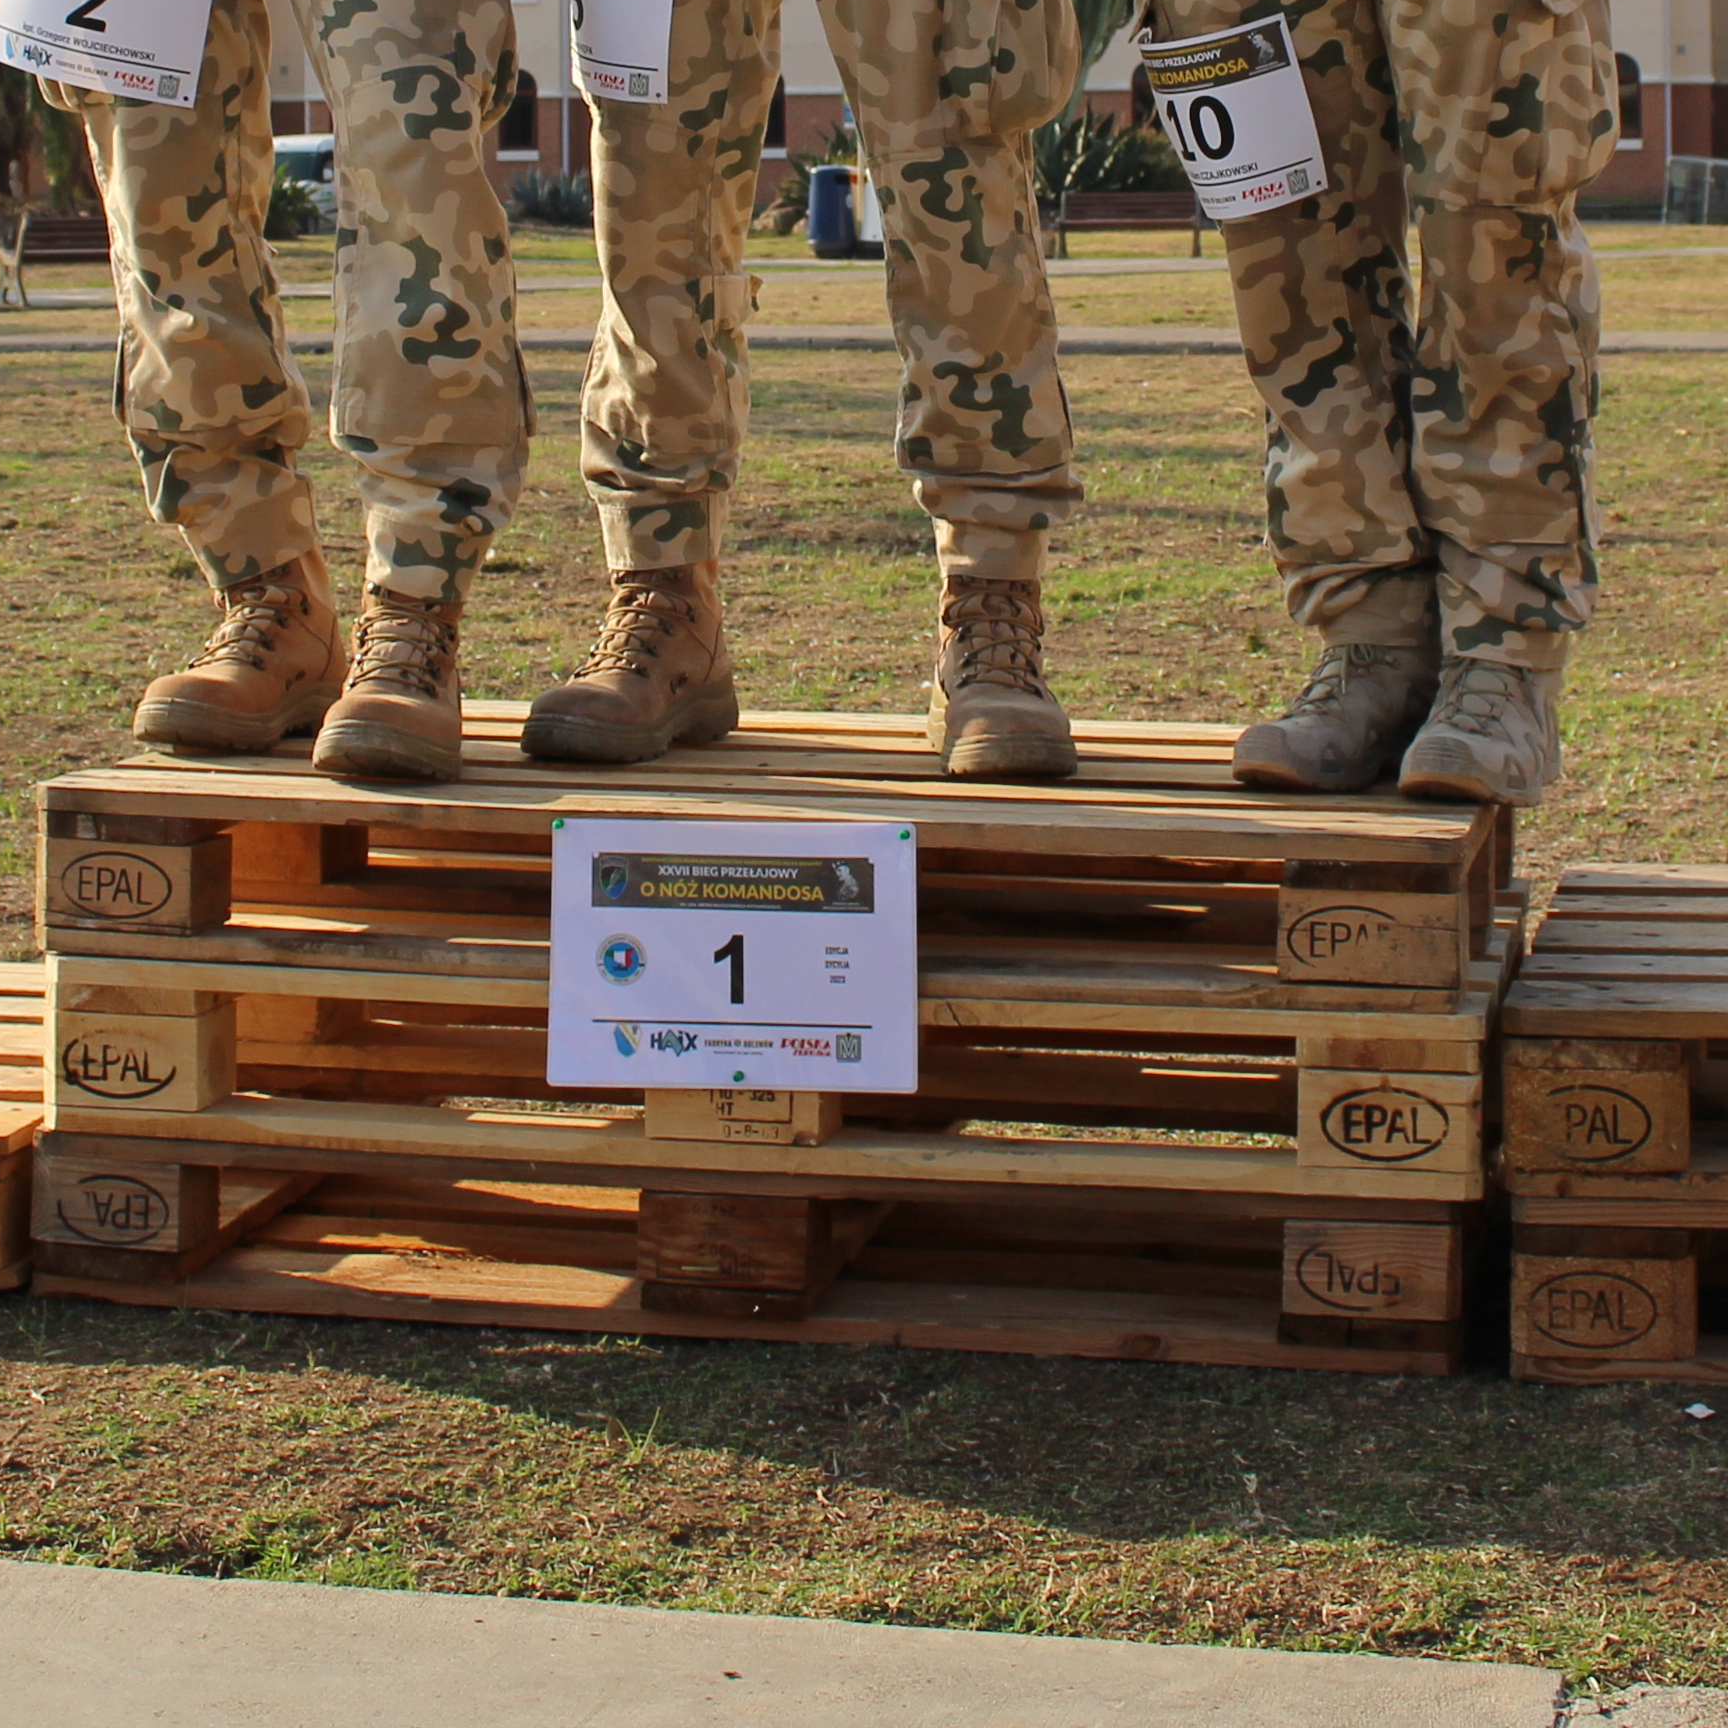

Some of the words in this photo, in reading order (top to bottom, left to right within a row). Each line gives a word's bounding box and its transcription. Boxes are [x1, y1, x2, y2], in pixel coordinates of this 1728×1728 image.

[36, 26, 72, 45] Grzegorz
[73, 37, 156, 62] WOJCIECHOWSKI
[1164, 48, 1222, 68] PRZEŁAJOWY
[1160, 57, 1249, 85] KOMANDOSA
[1166, 95, 1236, 162] 10
[1201, 162, 1259, 181] CZAJKOWSKI
[658, 865, 690, 876] XXVII
[692, 865, 719, 877] BIEG
[721, 866, 799, 880] PRZEŁAJOWY
[77, 865, 153, 906] EPAL
[640, 881, 655, 898] O
[659, 879, 699, 899] NÓŻ
[702, 882, 825, 902] KOMANDOSA
[825, 946, 849, 956] EDYCJA
[713, 934, 744, 1004] 1
[824, 960, 850, 970] SYCYLIA
[829, 975, 846, 984] 2023
[780, 1037, 832, 1051] POLSKA
[81, 1043, 162, 1084] EPAL
[1342, 1103, 1432, 1145] EPAL
[1548, 1289, 1639, 1332] EPAL
